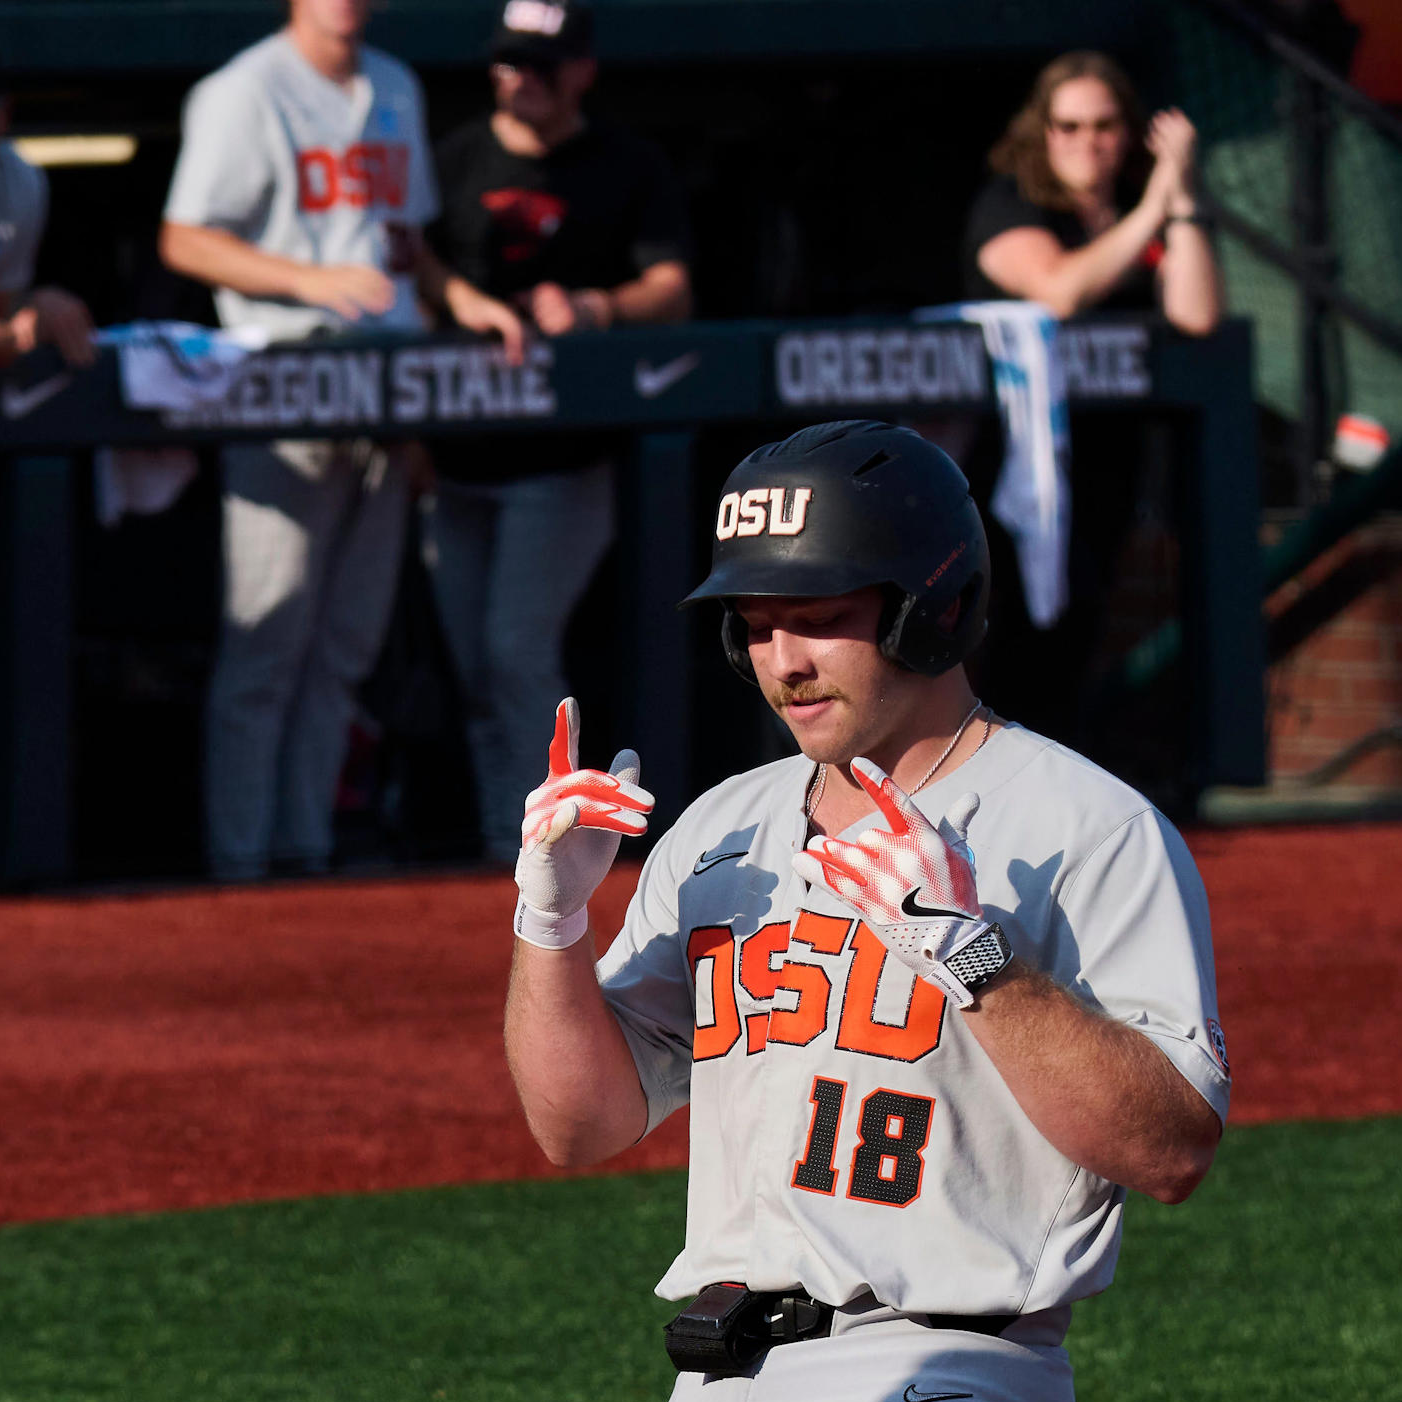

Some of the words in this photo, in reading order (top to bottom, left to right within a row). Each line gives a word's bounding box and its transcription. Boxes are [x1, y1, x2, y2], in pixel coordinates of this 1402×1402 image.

[777, 329, 985, 404] OREGON
[1063, 325, 1148, 392] ATE
[716, 487, 812, 541] OSU
[686, 908, 948, 1064] OSU
[790, 1075, 936, 1209] 18
